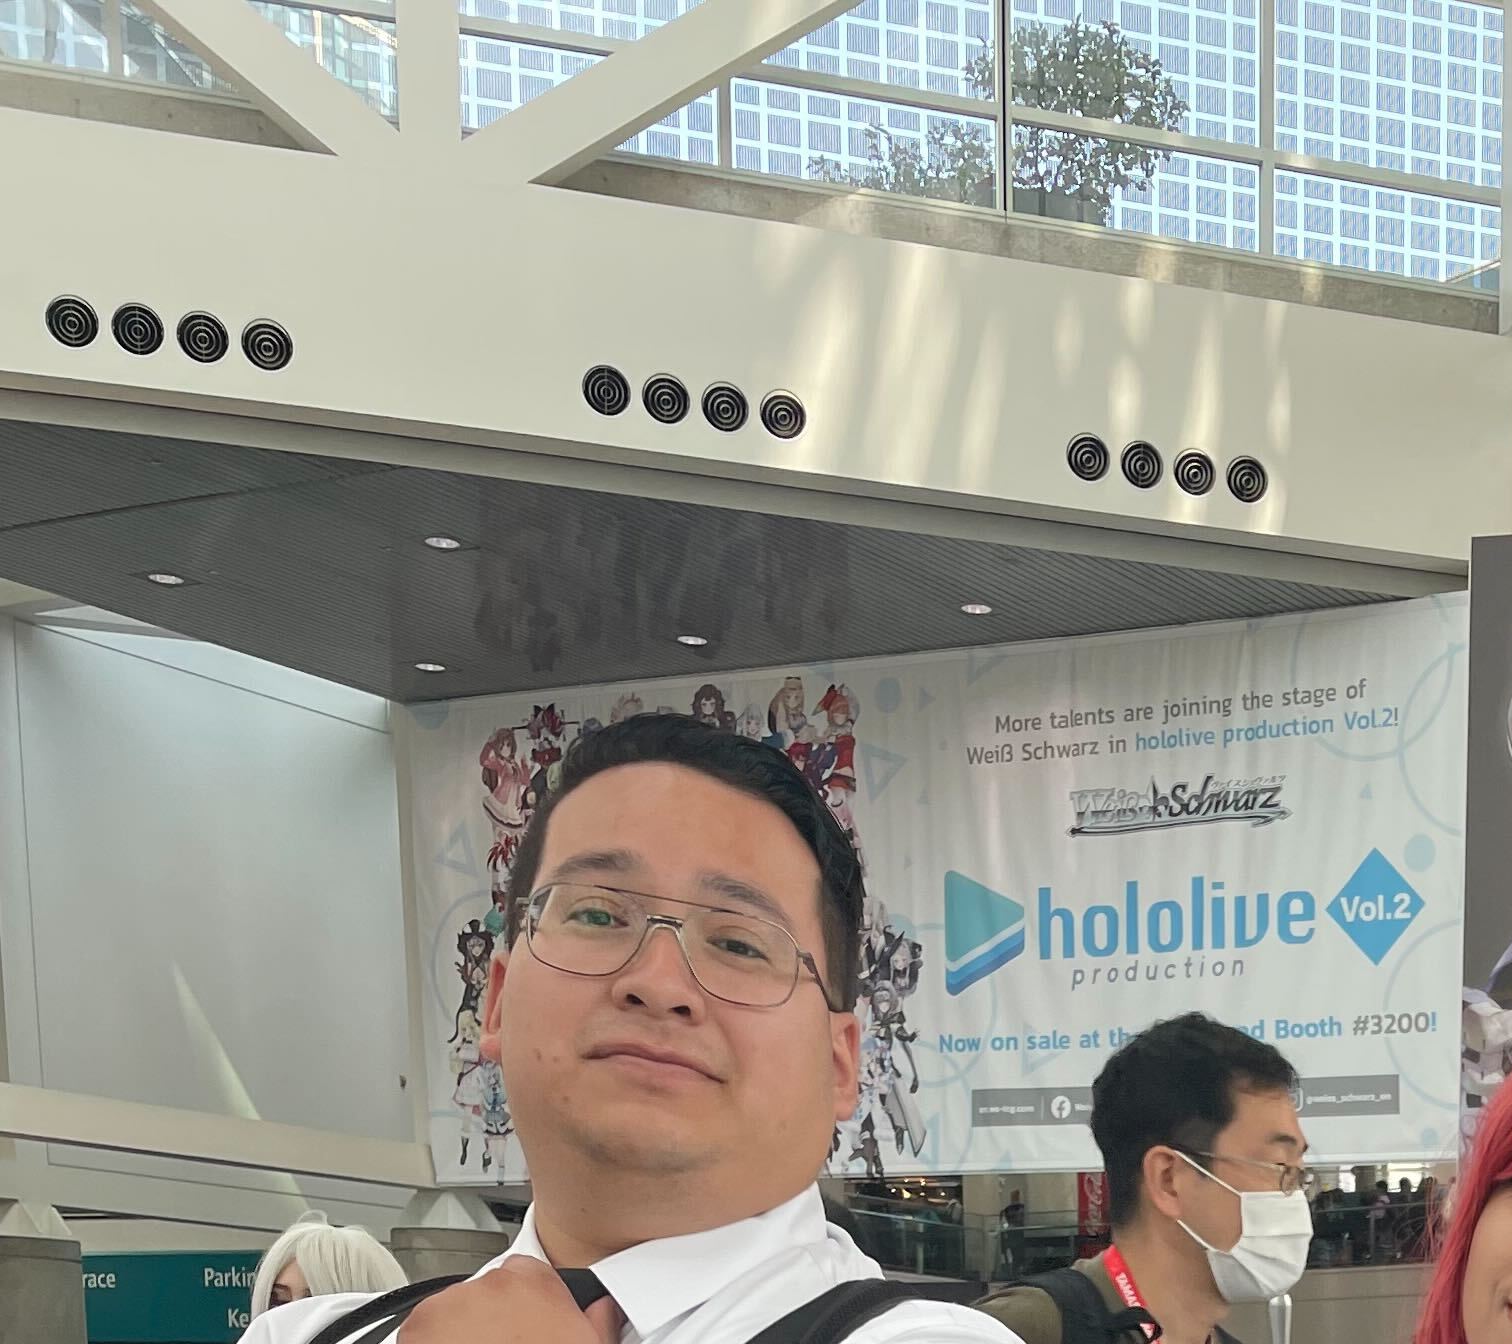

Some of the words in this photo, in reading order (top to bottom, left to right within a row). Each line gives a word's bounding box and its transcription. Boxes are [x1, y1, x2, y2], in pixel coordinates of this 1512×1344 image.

[994, 715, 1042, 734] More
[1050, 707, 1115, 730] talents
[1123, 705, 1154, 722] are
[1162, 695, 1233, 725] joining
[1242, 690, 1273, 711] the
[1282, 687, 1337, 708] stage
[1346, 678, 1368, 699] of
[966, 744, 1014, 765] Weiß
[1021, 740, 1100, 762] Schwarz
[1108, 734, 1127, 753] in
[1135, 726, 1216, 751] hololive
[1223, 716, 1334, 748] production
[1344, 707, 1399, 730] Vol.2!
[1038, 876, 1316, 960] hololive
[1340, 892, 1412, 923] Vol.2
[1071, 955, 1245, 991] production
[939, 1034, 981, 1053] Now
[991, 1035, 1018, 1051] on
[1026, 1030, 1071, 1050] sale
[1079, 1030, 1100, 1049] at
[1109, 1027, 1137, 1047] th
[1274, 1016, 1342, 1039] Booth
[1352, 1011, 1437, 1036] #3200!
[203, 1266, 256, 1288] Parkin
